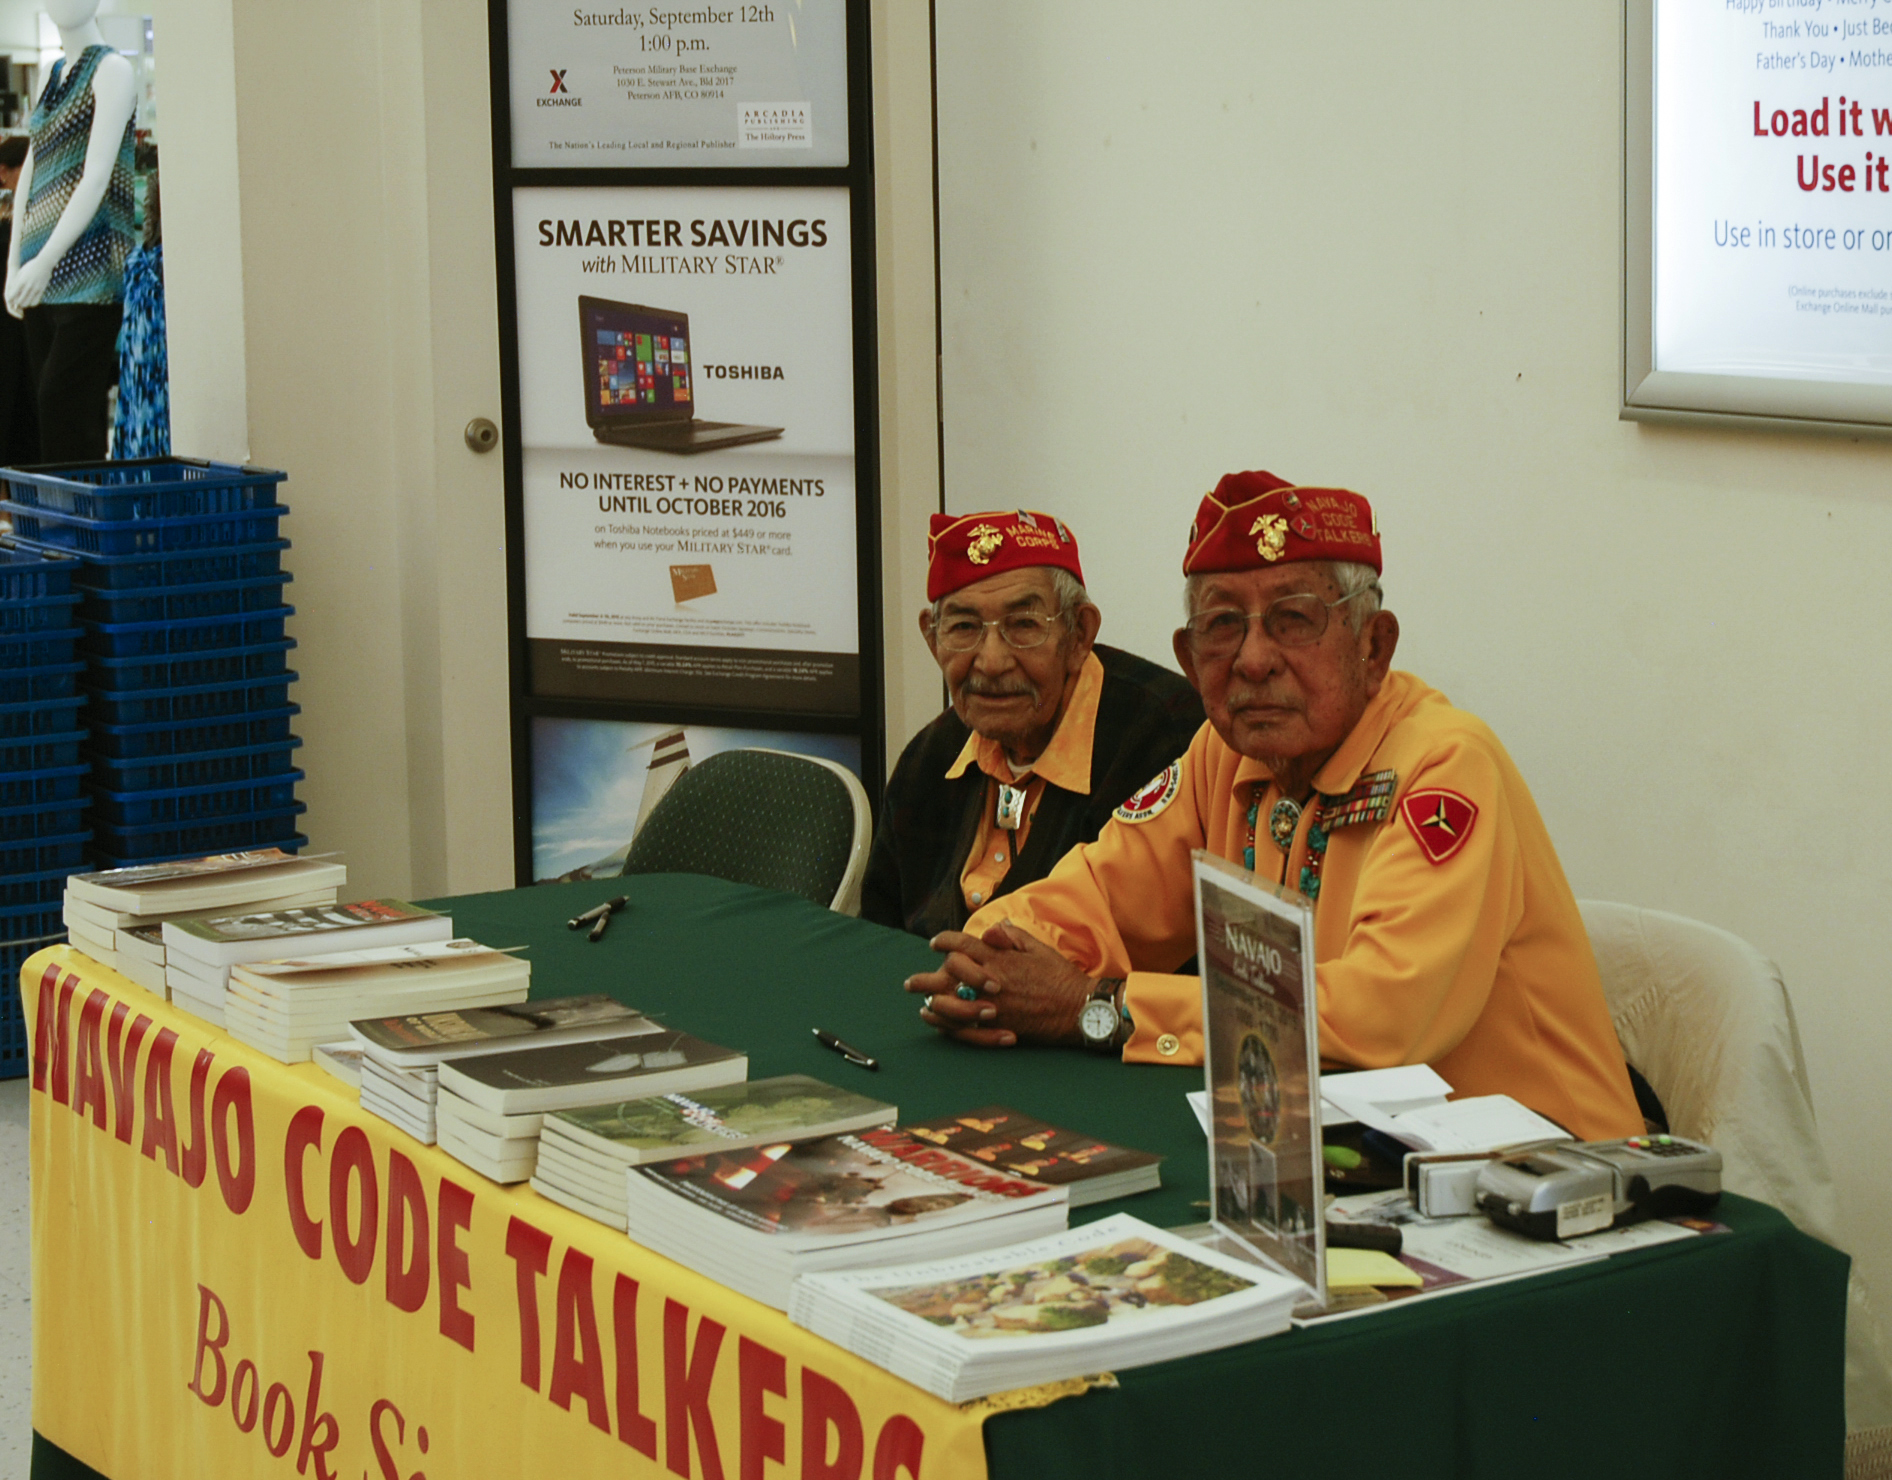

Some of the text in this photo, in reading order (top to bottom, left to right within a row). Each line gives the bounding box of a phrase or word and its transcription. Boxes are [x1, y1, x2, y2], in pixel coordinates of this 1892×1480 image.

[573, 5, 775, 31] Saturday, September 12th
[1763, 17, 1892, 41] Thank You Just Be
[639, 34, 710, 56] 1:00 p.m.
[613, 64, 738, 76] Peterson Military Base Exchange
[1756, 51, 1806, 70] Father's
[1810, 51, 1836, 73] Day
[647, 78, 676, 87] Stewart
[715, 77, 734, 86] 2017
[536, 98, 582, 107] EXCHANGE
[627, 91, 660, 100] Peterson
[684, 91, 699, 99] CO
[1754, 96, 1829, 137] Load
[1839, 95, 1864, 137] it
[549, 140, 736, 151] The Nation's Leading Local and Regional Publisher
[746, 132, 805, 142] The History Press
[1797, 151, 1890, 193] Use it
[538, 219, 828, 248] SMARTER SAVINGS
[1714, 220, 1751, 248] Use
[1758, 220, 1776, 248] in
[1783, 223, 1836, 250] store
[1843, 229, 1865, 251] or
[581, 255, 616, 273] with
[621, 254, 718, 274] MILITARY
[1818, 287, 1856, 299] purchases
[1833, 301, 1860, 314] Online
[1861, 303, 1879, 314] Mall
[703, 365, 785, 380] TOSHIBA
[560, 472, 825, 497] NO INTEREST + NO PAYMENTS
[599, 495, 786, 518] UNTIL OCTOBER 2016
[1305, 497, 1358, 518] NAVAJO
[594, 524, 792, 540] on Toshiba Notebooks priced at $449 or more
[593, 540, 618, 549] when
[619, 541, 636, 554] you
[637, 542, 653, 551] use
[655, 543, 674, 556] your
[677, 539, 734, 554] MILITARY
[771, 545, 793, 556] card.
[1224, 921, 1282, 976] NAVAJO
[32, 963, 256, 1214] NAVAJO
[284, 1105, 475, 1353] CODE
[187, 1283, 429, 1480] Book S
